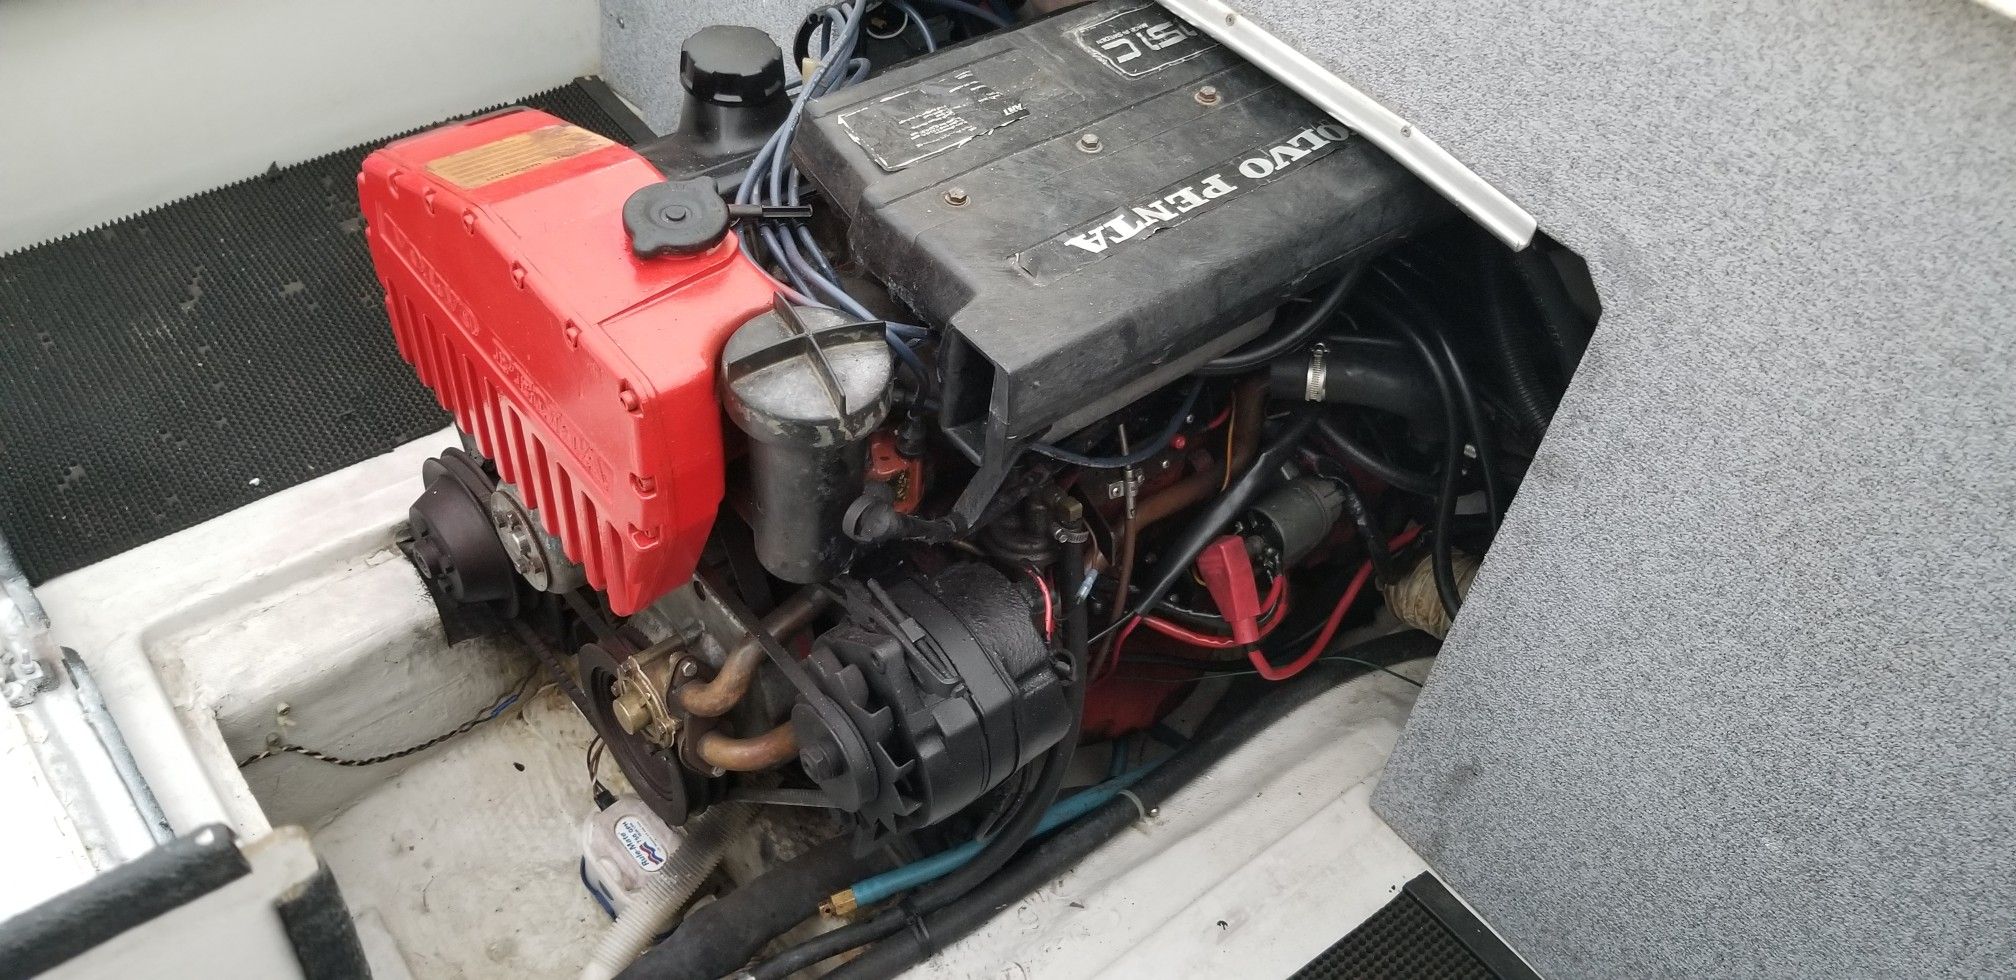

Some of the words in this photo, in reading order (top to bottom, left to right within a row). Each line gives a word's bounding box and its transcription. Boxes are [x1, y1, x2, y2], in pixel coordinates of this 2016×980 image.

[1238, 123, 1358, 179] OLVO
[1063, 173, 1238, 254] PENTA
[620, 832, 649, 867] Rule-Mate
